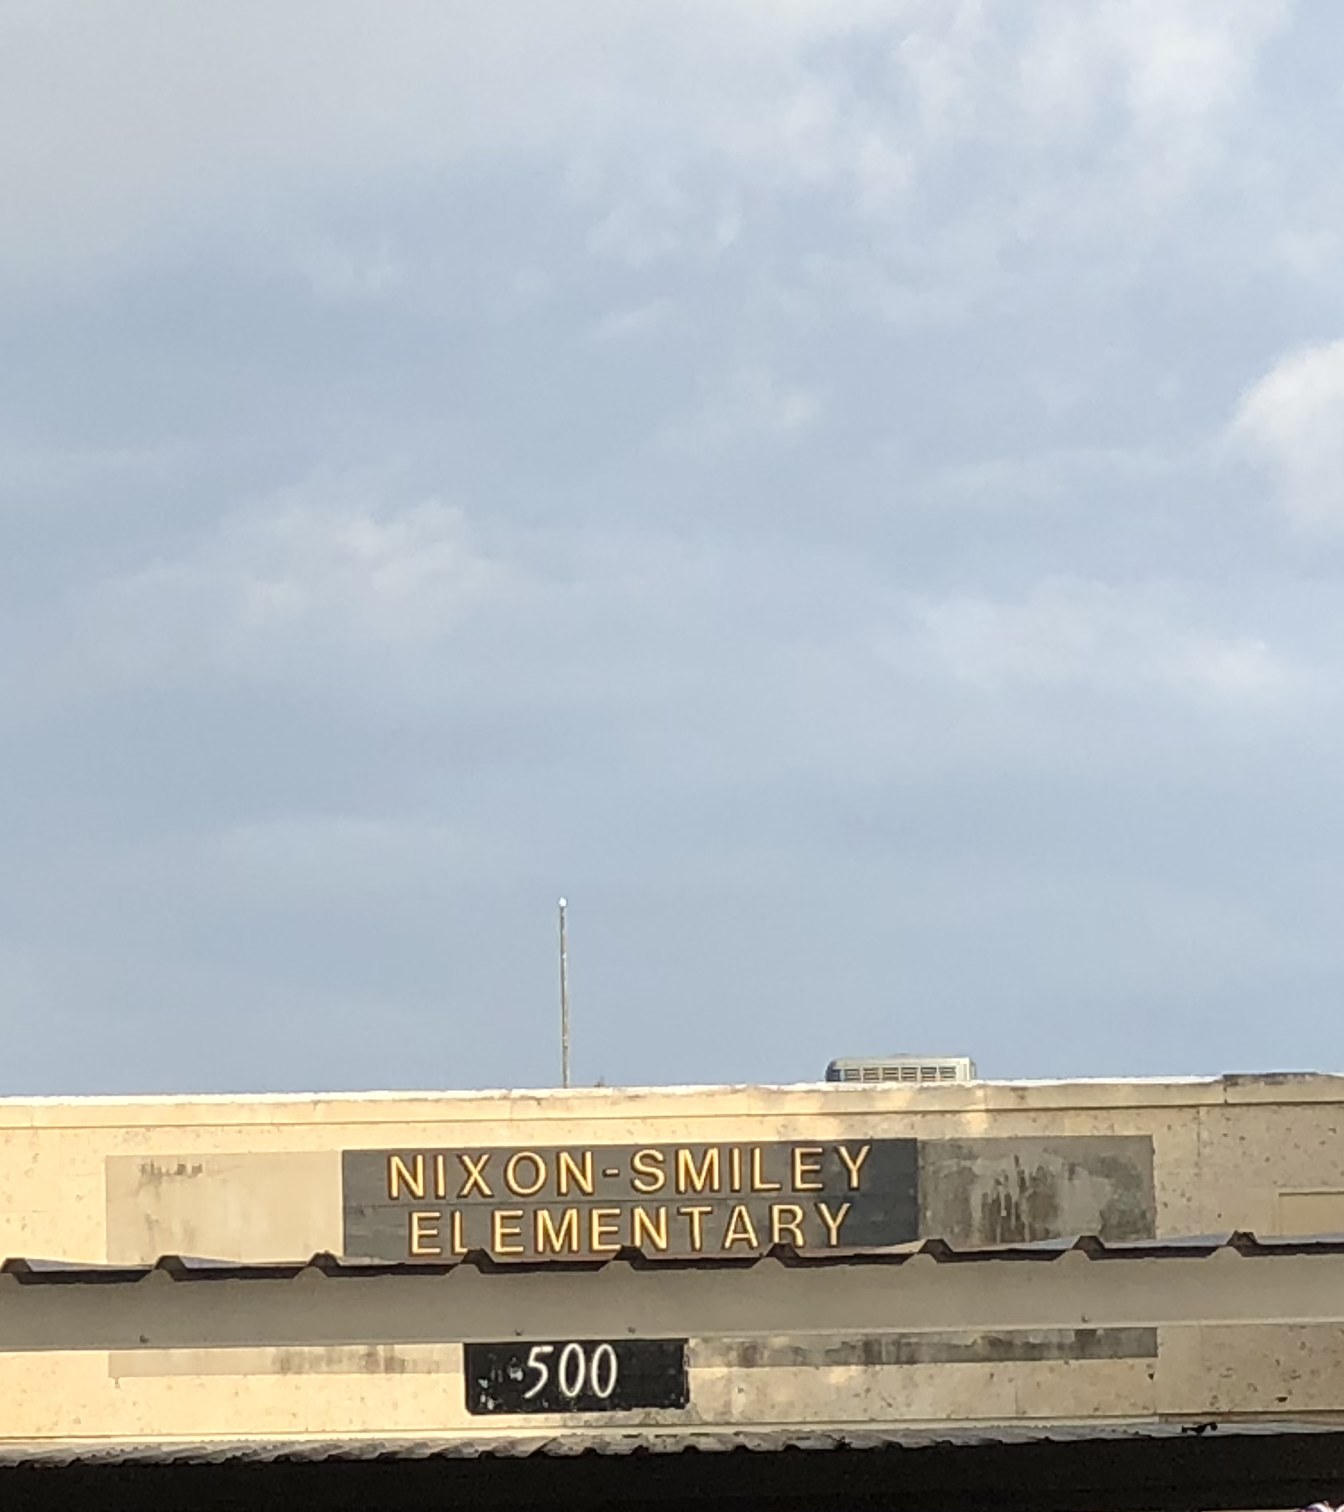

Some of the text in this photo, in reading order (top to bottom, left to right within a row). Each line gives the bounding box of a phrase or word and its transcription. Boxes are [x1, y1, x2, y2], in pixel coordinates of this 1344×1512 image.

[388, 1144, 871, 1199] NIXON-SMILEY
[408, 1201, 852, 1255] ELEMENTARY
[522, 1342, 618, 1399] 500
